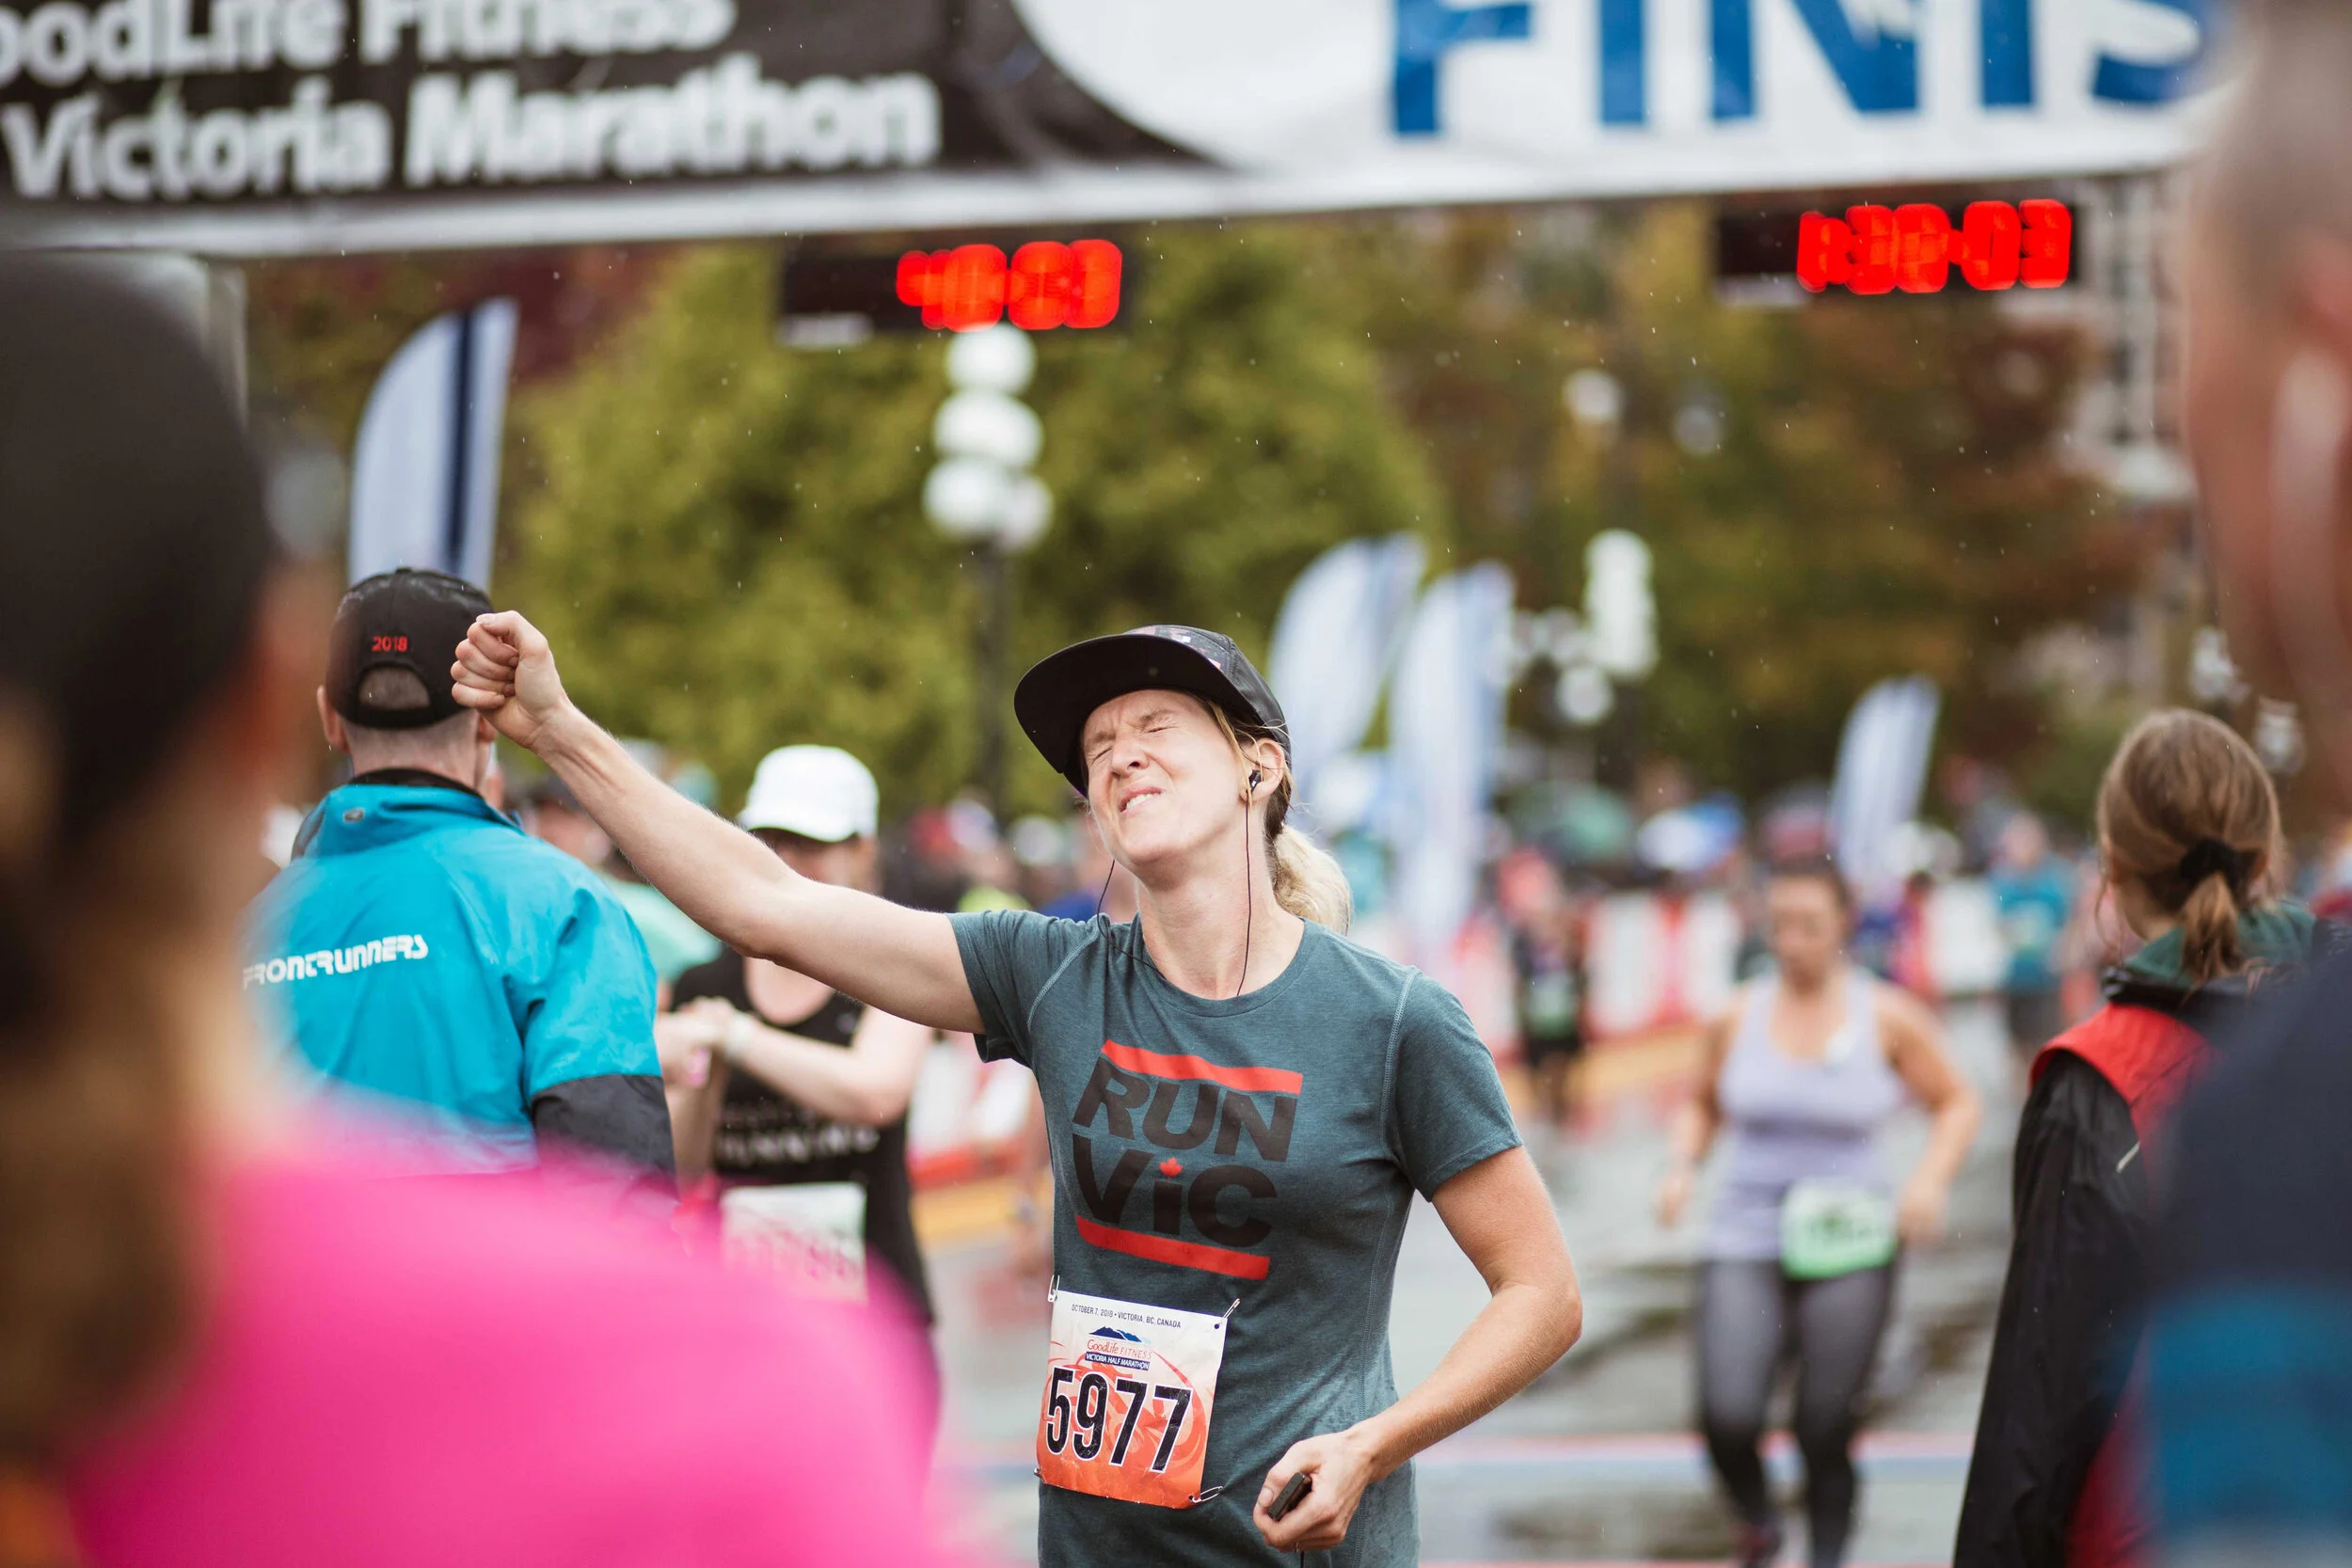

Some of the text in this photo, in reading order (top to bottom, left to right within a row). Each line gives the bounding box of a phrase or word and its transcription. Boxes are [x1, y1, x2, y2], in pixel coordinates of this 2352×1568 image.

[3, 54, 938, 198] Victoria Marathon
[372, 636, 407, 652] 2018
[1073, 1056, 1297, 1163] RUN
[1072, 1305, 1093, 1315] OCTOBER
[1157, 1319, 1181, 1328] CANADA
[1088, 1339, 1152, 1360] GoodLife FITNESS
[1086, 1354, 1107, 1363] VICTORIA
[1120, 1359, 1150, 1370] MARATHON
[1046, 1367, 1192, 1473] 5977
